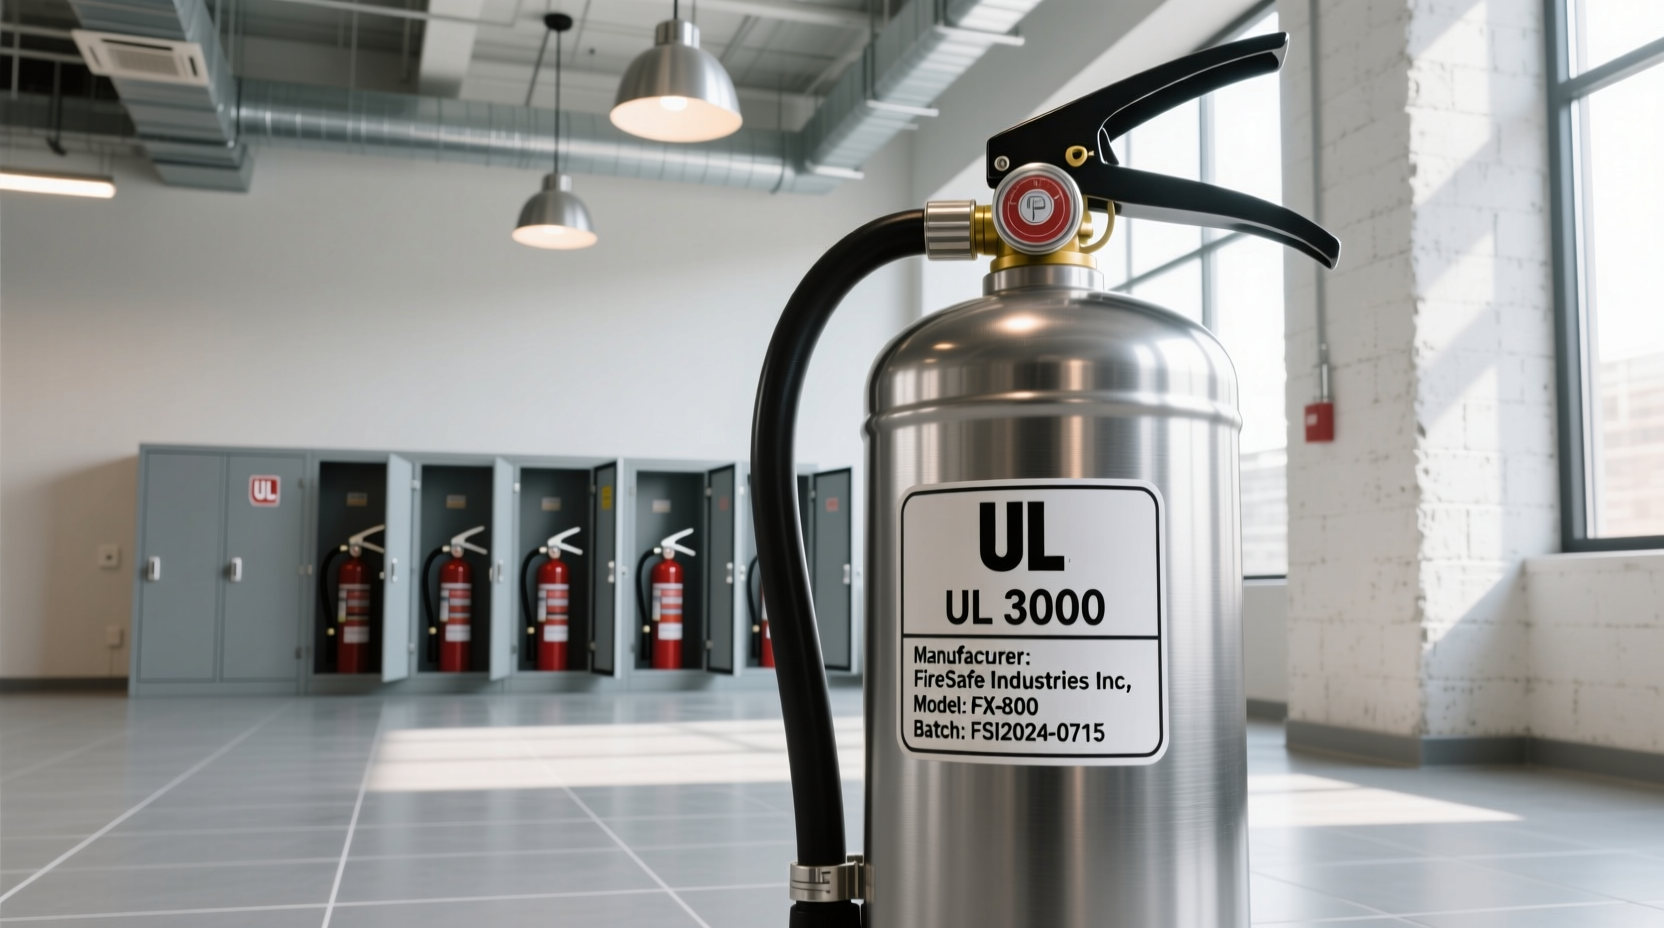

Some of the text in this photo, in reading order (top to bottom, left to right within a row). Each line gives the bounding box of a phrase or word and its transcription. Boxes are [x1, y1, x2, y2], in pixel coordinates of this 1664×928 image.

[253, 479, 277, 501] UL
[979, 501, 1065, 572] UL
[946, 588, 1105, 626] UL 3000
[914, 669, 1132, 694] FireSafe Industries Inc,
[913, 694, 1039, 716] Model: FX-800
[913, 719, 1105, 743] Batch: FSI2024-0715
